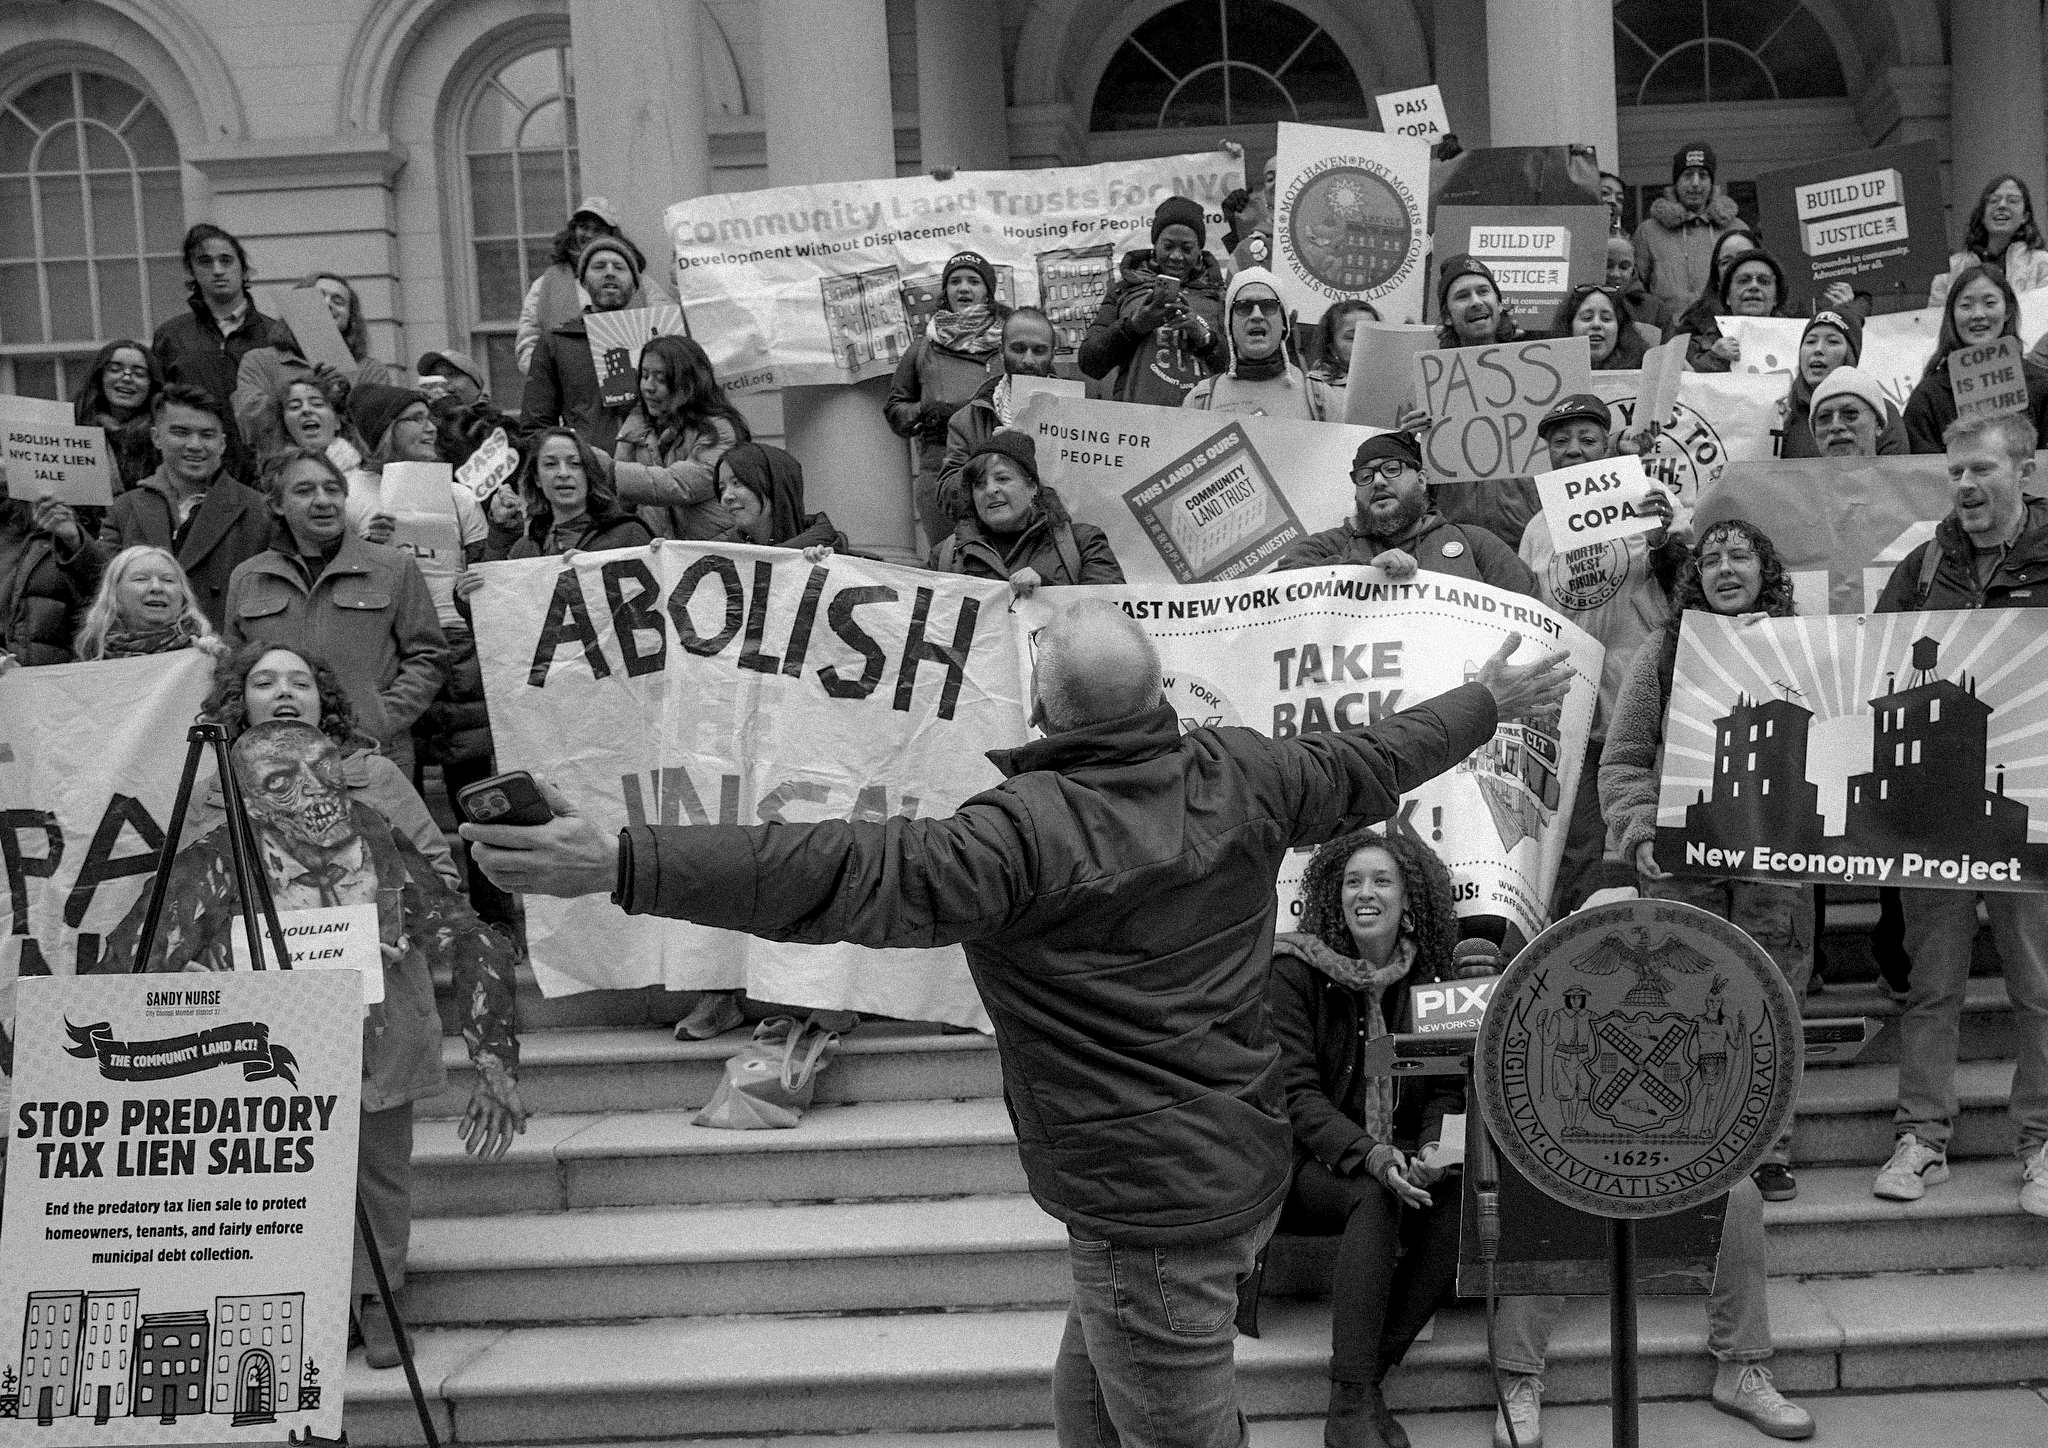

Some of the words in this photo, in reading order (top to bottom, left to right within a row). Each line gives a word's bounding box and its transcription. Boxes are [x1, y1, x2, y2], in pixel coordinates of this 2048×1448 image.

[1395, 98, 1428, 116] PASS
[1398, 121, 1439, 137] COPA
[1306, 155, 1348, 179] HAVEN
[1357, 157, 1391, 179] PORT
[1281, 175, 1304, 213] MOTT
[1390, 175, 1421, 226] MORRIS
[1806, 185, 1859, 210] BUILD
[1861, 179, 1886, 199] UP
[674, 199, 881, 247] Community
[892, 188, 977, 220] Land
[986, 187, 1100, 216] Trusts
[1172, 172, 1241, 202] NYC
[679, 245, 791, 271] Development
[794, 239, 860, 258] Without
[864, 221, 972, 248] Displacement
[1003, 222, 1068, 239] Housing
[1100, 217, 1153, 232] People
[1478, 234, 1529, 249] BUILD
[1533, 234, 1556, 249] UP
[1816, 220, 1884, 246] JUSTICE
[1278, 226, 1320, 293] STEWARDS
[1366, 239, 1420, 301] COMMUNITY
[1494, 270, 1545, 284] USTICE
[1323, 286, 1364, 301] LAND
[1961, 343, 2010, 368] COPA
[722, 372, 774, 392] ccli.org
[1421, 343, 1562, 417] PASS
[1956, 378, 1975, 394] IS
[1979, 366, 2015, 388] THE
[9, 432, 60, 447] ABOLISH
[64, 438, 92, 449] THE
[1039, 422, 1110, 444] HOUSING
[1117, 433, 1151, 448] FOR
[9, 449, 32, 461] NYC
[34, 452, 59, 464] TAX
[63, 455, 96, 466] LIEN
[1060, 449, 1124, 467] PEOPLE
[1132, 482, 1163, 507] THIS
[1160, 463, 1195, 490] LAND
[1192, 452, 1208, 469] IS
[1205, 432, 1240, 461] OURS
[35, 469, 66, 481] SALE
[475, 454, 517, 497] COPA
[1185, 464, 1246, 511] COMMUNITY
[1564, 471, 1621, 500] PASS
[1192, 500, 1223, 528] LAND
[1219, 476, 1257, 510] TRUST
[1568, 501, 1639, 533] COPA
[1213, 559, 1248, 582] TIERRA
[1244, 549, 1261, 566] ES
[1256, 526, 1298, 559] NUESTRA
[1568, 557, 1600, 576] WEST
[1568, 569, 1608, 592] BRONX
[1168, 598, 1221, 619] NEW
[1225, 586, 1281, 614] YORK
[1285, 579, 1430, 602] COMMUNITY
[1435, 585, 1497, 613] LAND
[1500, 602, 1562, 639] TRUST
[527, 554, 982, 721] ABOLISH
[1273, 640, 1403, 691] TAKE
[1190, 682, 1221, 709] YORK
[1273, 688, 1404, 740] BACK
[1526, 730, 1548, 754] CLT
[1686, 840, 1746, 869] New
[1752, 846, 1895, 881] Economy
[1902, 852, 2022, 884] Project
[1453, 882, 1480, 903] US!
[309, 948, 344, 960] LIEN
[146, 991, 183, 1006] SANDY
[185, 990, 221, 1005] NURSE
[1416, 983, 1490, 1019] PIX
[1418, 1023, 1441, 1033] NEW
[1440, 1018, 1476, 1031] YORK'S
[110, 1053, 132, 1068] THE
[133, 1046, 199, 1069] COMMUNITY
[202, 1040, 232, 1055] LAND
[234, 1038, 258, 1052] ACT!
[17, 1100, 109, 1139] STOP
[121, 1095, 338, 1136] PREDATORY
[1503, 1037, 1545, 1145] SIGILLVM
[1543, 1147, 1670, 1197] CIVITATIS
[1676, 1141, 1738, 1188] NOVI
[1736, 1041, 1774, 1142] EBORACI
[36, 1141, 105, 1179] TAX
[116, 1139, 196, 1177] LIEN
[207, 1136, 315, 1176] SALES
[45, 1201, 69, 1216] End
[73, 1200, 94, 1215] the
[97, 1200, 160, 1217] predatory
[163, 1199, 183, 1213] tax
[187, 1198, 211, 1212] lien
[215, 1198, 242, 1212] sale
[245, 1198, 259, 1211] to
[262, 1196, 307, 1212] protect
[45, 1226, 132, 1240] homeowners,
[136, 1225, 187, 1239] tenants,
[191, 1223, 215, 1237] and
[219, 1222, 251, 1238] fairly
[255, 1221, 304, 1235] enforce
[92, 1249, 154, 1264] municipal
[157, 1249, 187, 1262] debt
[190, 1247, 254, 1261] collection.
